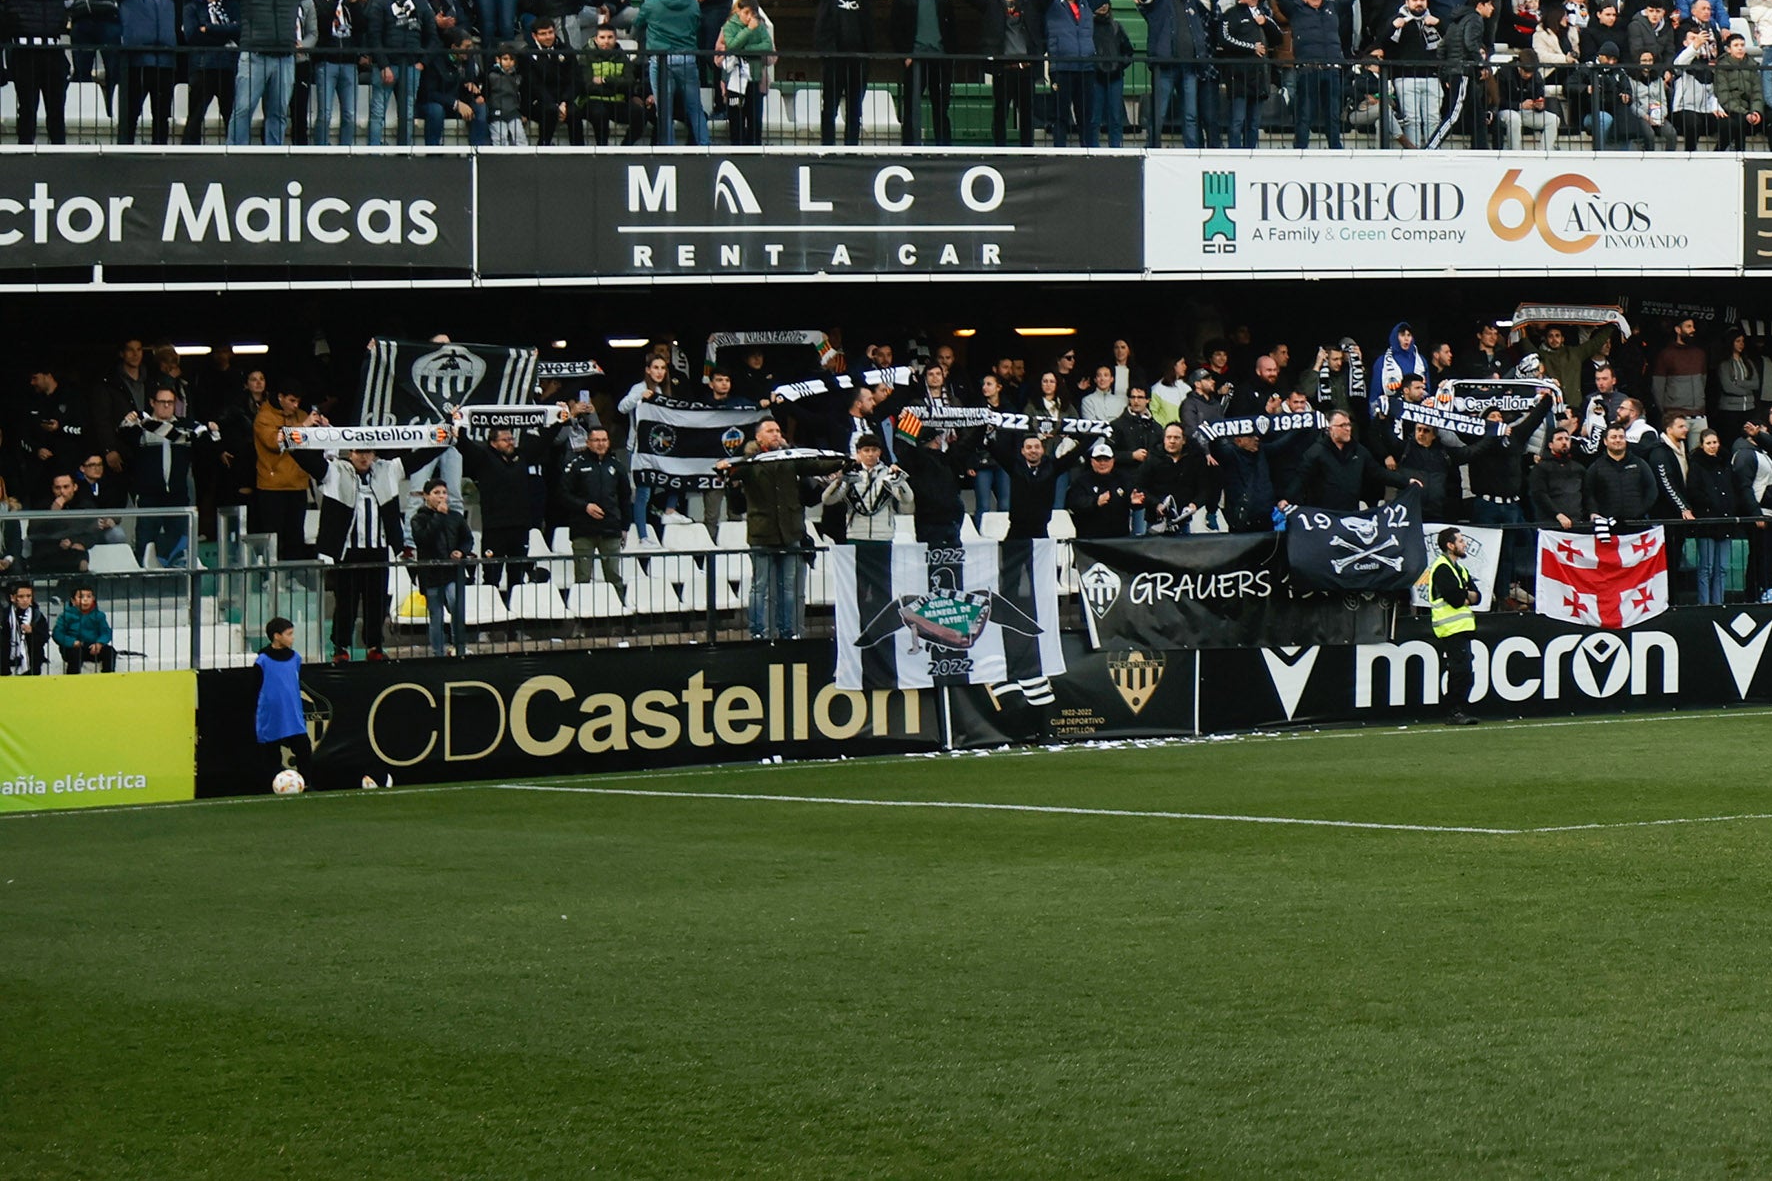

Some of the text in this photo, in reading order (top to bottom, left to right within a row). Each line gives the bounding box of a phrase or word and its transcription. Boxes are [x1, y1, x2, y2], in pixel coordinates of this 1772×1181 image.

[627, 159, 1006, 215] MALCO
[1250, 181, 1465, 222] TORRECID
[162, 180, 439, 247] Maicas
[1563, 193, 1651, 233] AÑOS
[1252, 227, 1264, 241] A
[1268, 225, 1320, 244] Family
[1339, 226, 1386, 241] Green
[1391, 225, 1467, 244] Company
[1603, 234, 1689, 250] INNOVANDO
[635, 243, 1002, 268] RENT A CAR
[1465, 395, 1530, 412] Castellón
[471, 412, 545, 428] C.D. CASTELLON
[1212, 412, 1313, 437] GNB 1922
[313, 425, 424, 443] CDCastellón
[640, 471, 682, 488] 1996
[925, 548, 967, 564] 1922
[1129, 570, 1273, 606] GRAUERS
[926, 658, 975, 677] 2022
[1050, 716, 1106, 726] CLUB DEPORTIVO
[1061, 707, 1093, 716] 1922-2022
[52, 769, 147, 795] eléctrica
